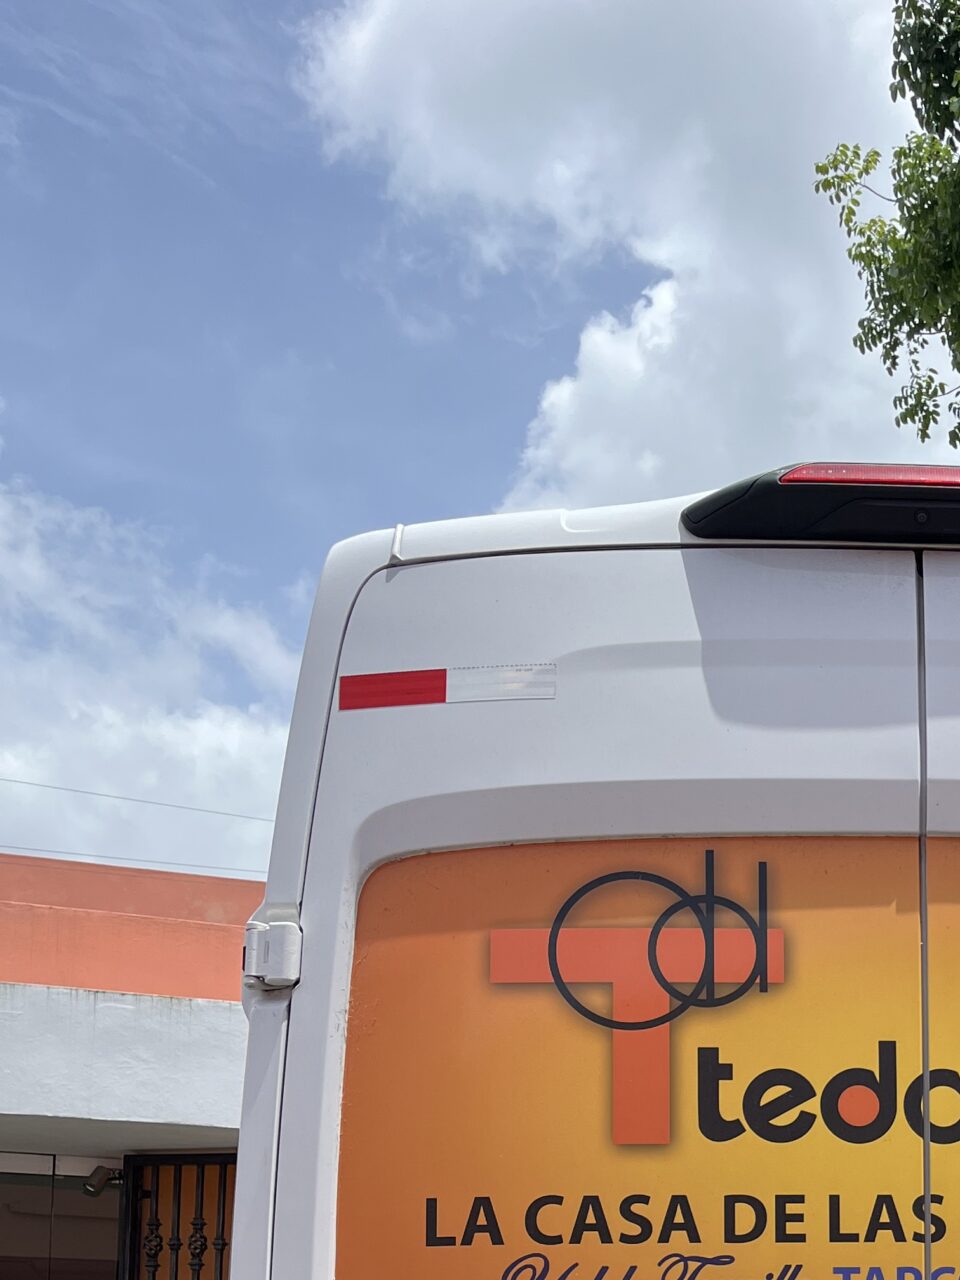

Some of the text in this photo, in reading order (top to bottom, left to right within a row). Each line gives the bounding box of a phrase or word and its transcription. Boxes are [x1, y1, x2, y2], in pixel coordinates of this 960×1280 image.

[424, 1196, 505, 1247] LA
[523, 1194, 702, 1246] CASA
[722, 1194, 808, 1244] DE
[827, 1193, 948, 1244] LAS
